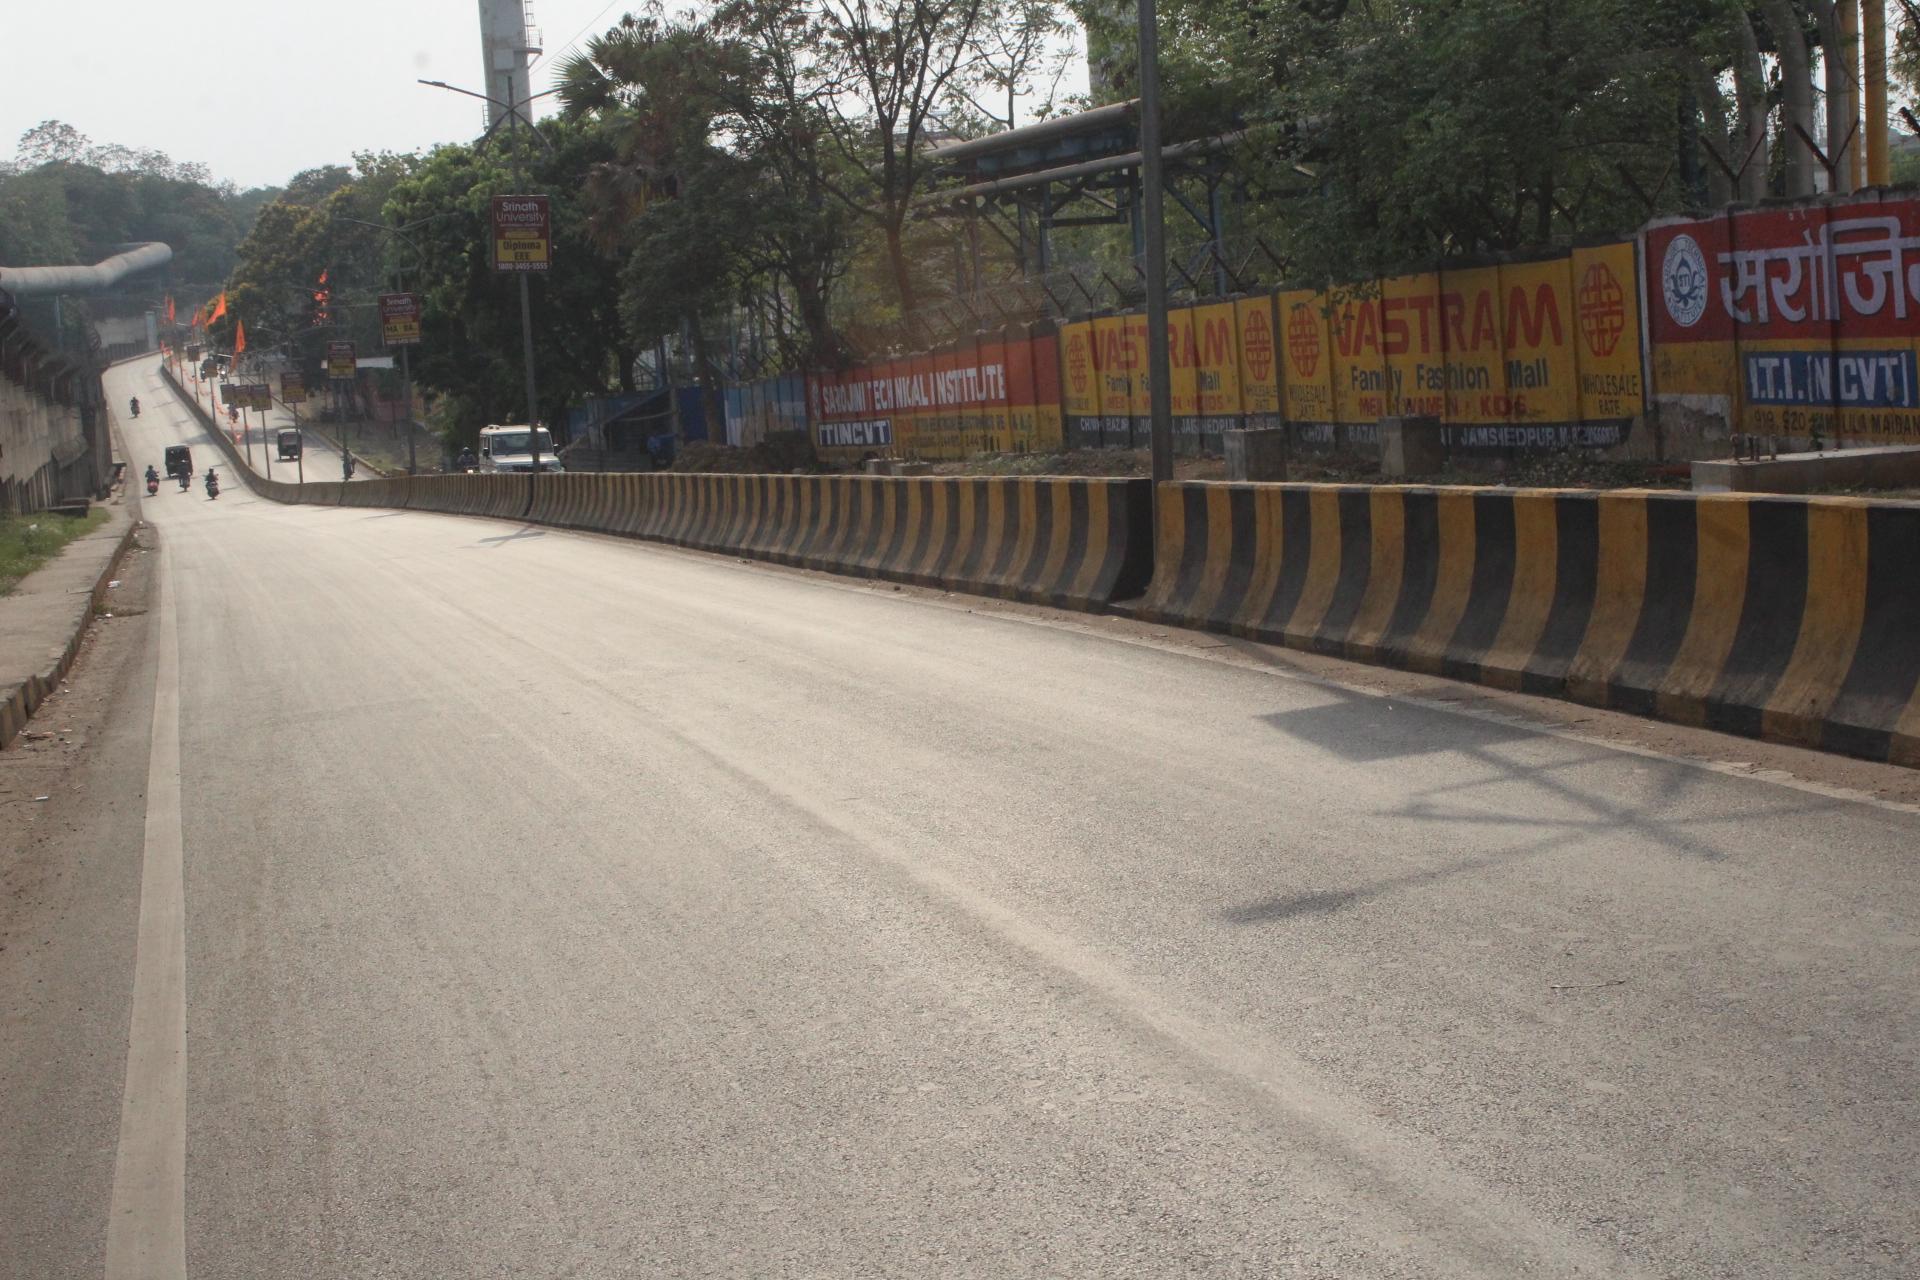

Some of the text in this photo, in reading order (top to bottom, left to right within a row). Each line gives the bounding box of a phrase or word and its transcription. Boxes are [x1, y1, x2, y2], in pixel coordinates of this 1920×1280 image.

[502, 201, 538, 212] Srinath
[496, 212, 546, 223] University
[503, 241, 541, 251] Diploma
[514, 252, 531, 261] EEE
[1679, 273, 1691, 287] STI
[386, 298, 412, 306] Srinath
[1332, 283, 1563, 358] VASTRAM
[930, 364, 1006, 405] INSTITUTE
[1200, 370, 1221, 392] Mall
[1350, 357, 1549, 398] Family Fashion Mall
[1581, 373, 1639, 396] WHOLESALE
[1598, 400, 1621, 415] RATE
